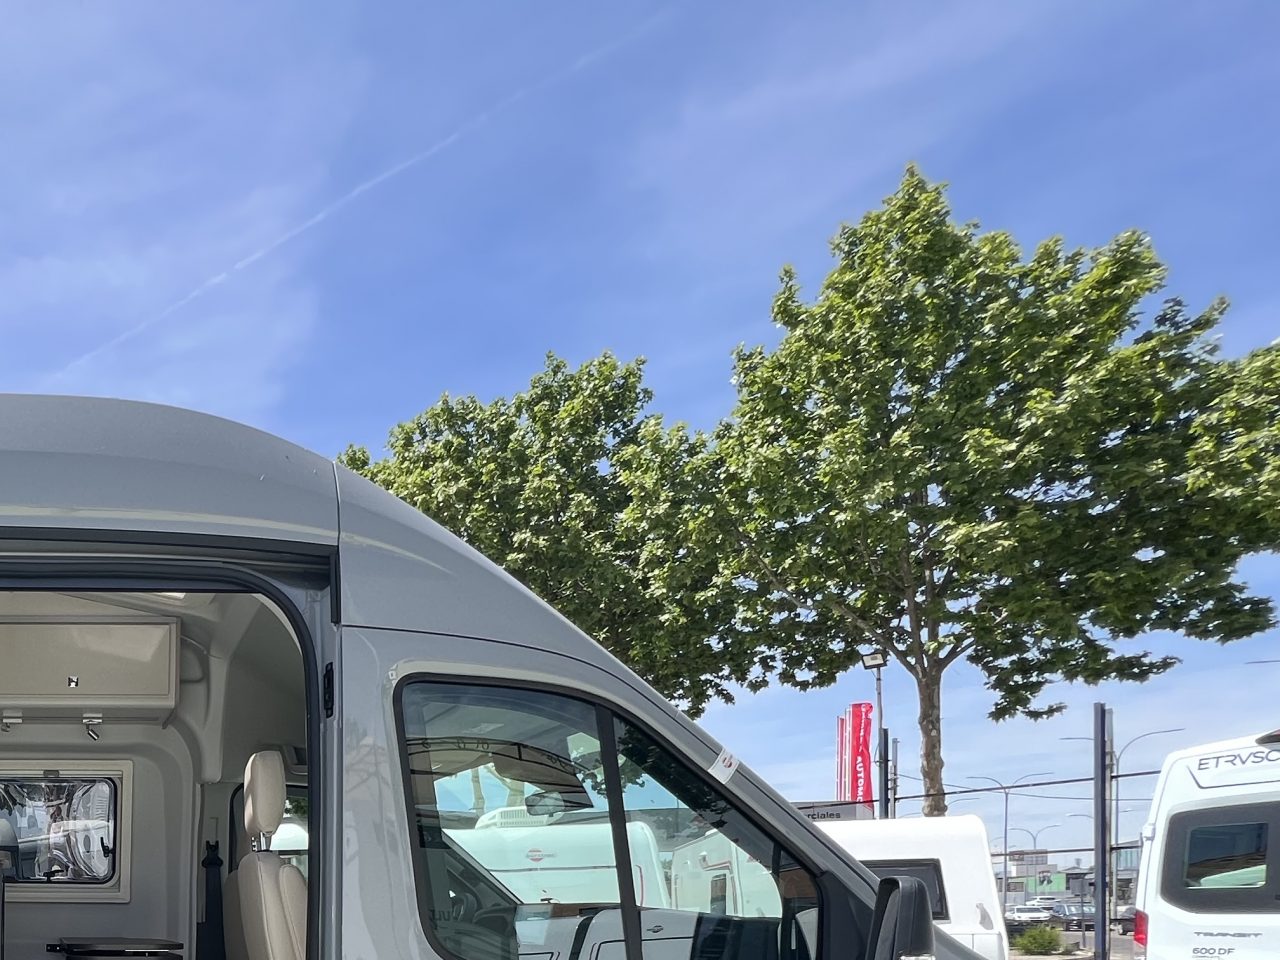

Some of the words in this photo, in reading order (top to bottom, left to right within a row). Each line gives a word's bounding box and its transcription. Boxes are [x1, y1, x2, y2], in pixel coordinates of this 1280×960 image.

[806, 811, 841, 820] rciales
[1192, 947, 1216, 955] 600
[1218, 947, 1236, 955] DF
